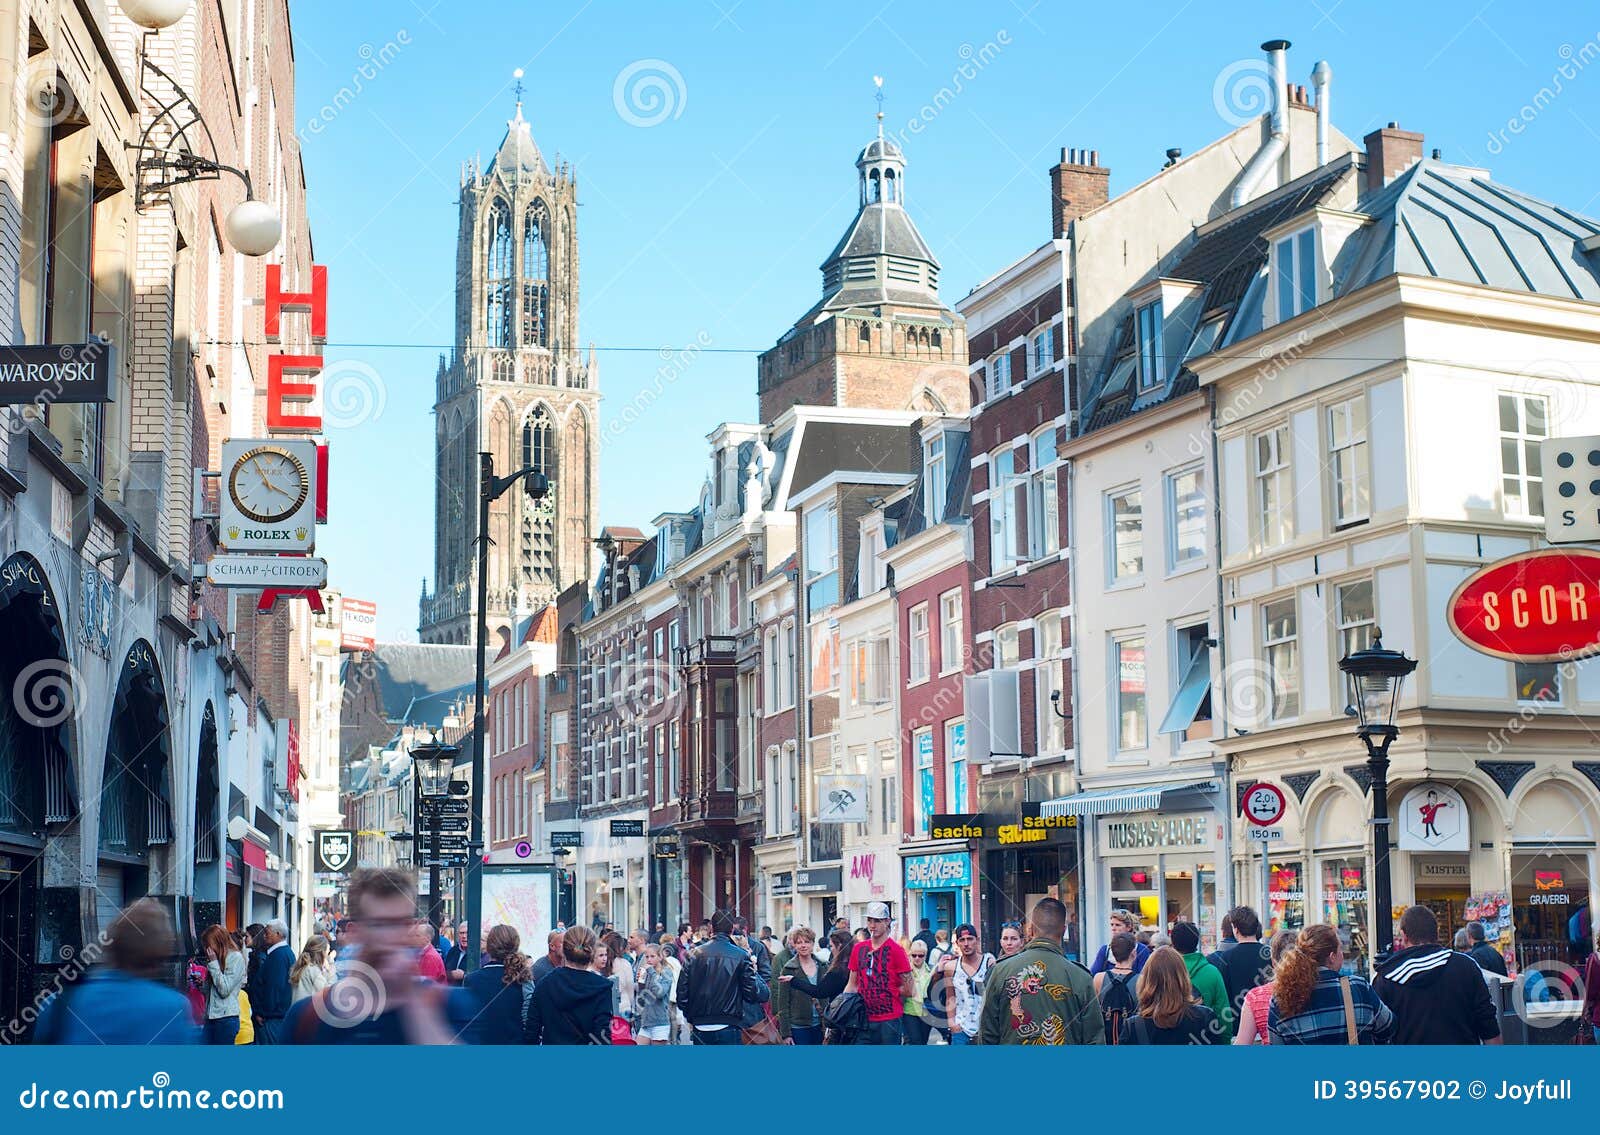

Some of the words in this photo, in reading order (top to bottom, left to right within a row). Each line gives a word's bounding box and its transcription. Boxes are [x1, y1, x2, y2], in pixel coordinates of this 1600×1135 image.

[0, 362, 96, 382] WAROVSKI
[243, 530, 291, 540] ROLEX
[214, 565, 259, 575] SCHAAP
[271, 565, 320, 577] CITROEN
[1483, 581, 1600, 631] SCOR
[933, 823, 983, 839] sacha
[1251, 830, 1269, 839] 150
[907, 861, 964, 882] SNEAKERS
[1425, 864, 1467, 875] MISTER
[1529, 894, 1570, 905] GRAVEREN
